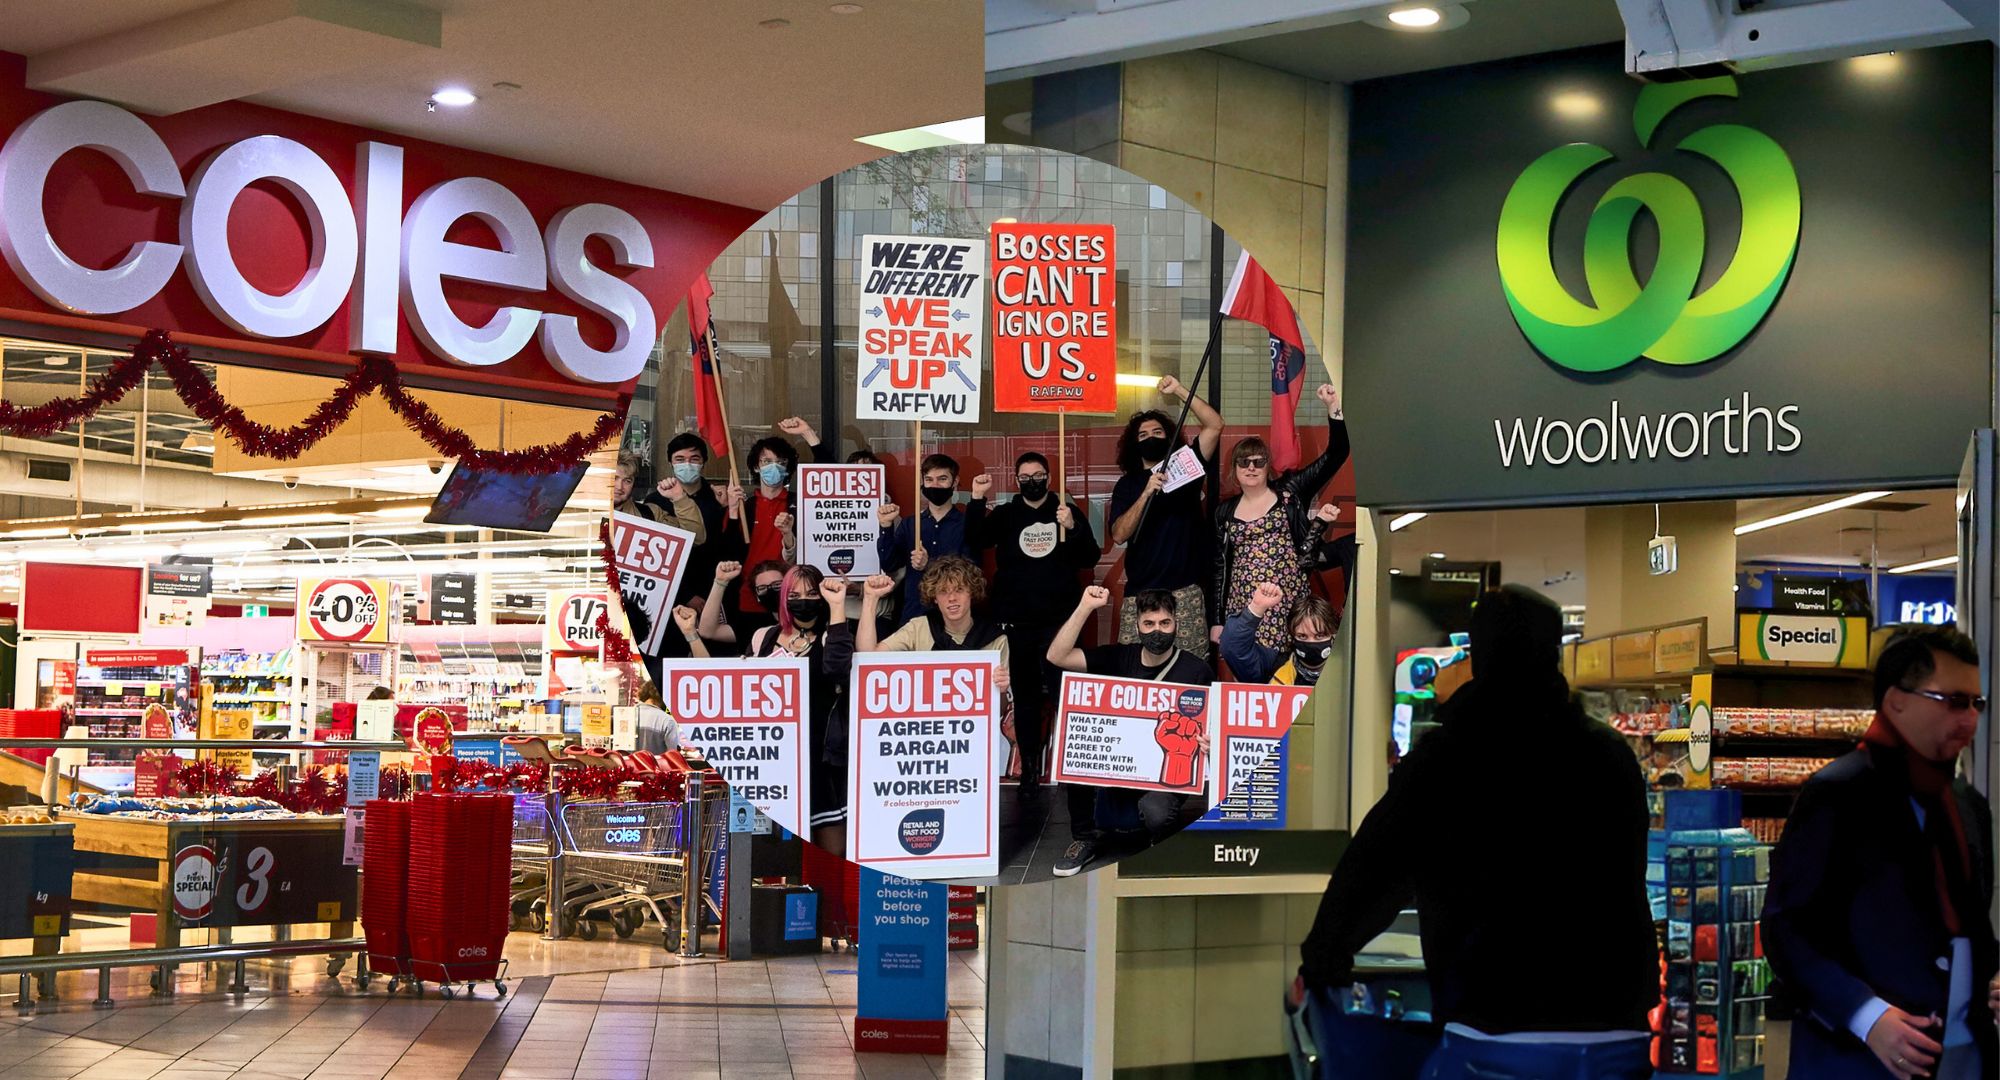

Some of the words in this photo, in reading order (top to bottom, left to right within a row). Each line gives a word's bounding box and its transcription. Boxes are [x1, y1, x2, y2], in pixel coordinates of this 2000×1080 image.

[0, 101, 656, 383] coles
[997, 233, 1106, 262] BOSSES
[871, 242, 971, 271] WE'RE
[864, 270, 980, 298] DIFFERENT
[995, 265, 1107, 306] CAN'T
[883, 297, 950, 328] WE
[997, 311, 1108, 338] IGNORE
[864, 329, 973, 358] SPEAK
[1020, 341, 1097, 381] US.
[890, 359, 946, 389] UP
[1030, 386, 1084, 397] RAFFWU
[873, 391, 967, 414] RAFFWU
[807, 471, 877, 496] COLES!
[815, 500, 853, 509] AGREE
[856, 500, 871, 509] TO
[816, 511, 868, 520] BARGAIN
[826, 522, 856, 531] WITH
[813, 533, 874, 542] WORKERS!
[634, 575, 656, 591] TO
[1784, 587, 1806, 595] Health
[1808, 587, 1825, 596] Food
[310, 594, 375, 622] 40%
[1795, 602, 1825, 610] Vitamins
[355, 614, 375, 623] OFF
[1768, 626, 1837, 646] Special
[677, 674, 793, 719] COLES!
[865, 668, 985, 714] COLES!
[1068, 680, 1105, 708] HEY
[1110, 684, 1177, 712] COLES!
[1228, 690, 1282, 728] HEY
[878, 720, 944, 737] AGREE
[948, 719, 974, 735] TO
[1070, 715, 1096, 724] WHAT
[1099, 718, 1118, 726] ARE
[690, 726, 754, 741] AGREE
[758, 726, 784, 741] TO
[1070, 724, 1088, 732] YOU
[1091, 726, 1104, 734] SO
[1068, 734, 1100, 742] AFRAID
[1104, 736, 1122, 744] OF?
[1690, 731, 1710, 746] Special
[879, 739, 969, 756] BARGAIN
[1067, 743, 1098, 752] AGREE
[1066, 752, 1108, 761] BARGAIN
[1110, 755, 1133, 763] WITH
[1232, 755, 1260, 766] YOU
[897, 759, 949, 775] WITH
[1066, 761, 1110, 770] WORKERS
[1112, 764, 1137, 773] NOW!
[873, 778, 978, 797] WORKERS!
[884, 799, 960, 808] #colesbargainnow
[606, 814, 636, 823] Welcome
[637, 815, 645, 823] to
[605, 827, 641, 843] coles
[1214, 844, 1260, 866] Entry
[718, 856, 726, 877] Sun
[176, 881, 214, 892] SPECIAL
[236, 846, 274, 911] 3
[280, 882, 291, 891] EA
[36, 891, 48, 904] kg
[718, 881, 726, 912] erald
[876, 889, 928, 898] check-in
[882, 901, 922, 912] before
[874, 915, 896, 925] you
[900, 914, 930, 926] shop
[458, 945, 487, 958] coles
[861, 1030, 889, 1039] coles
